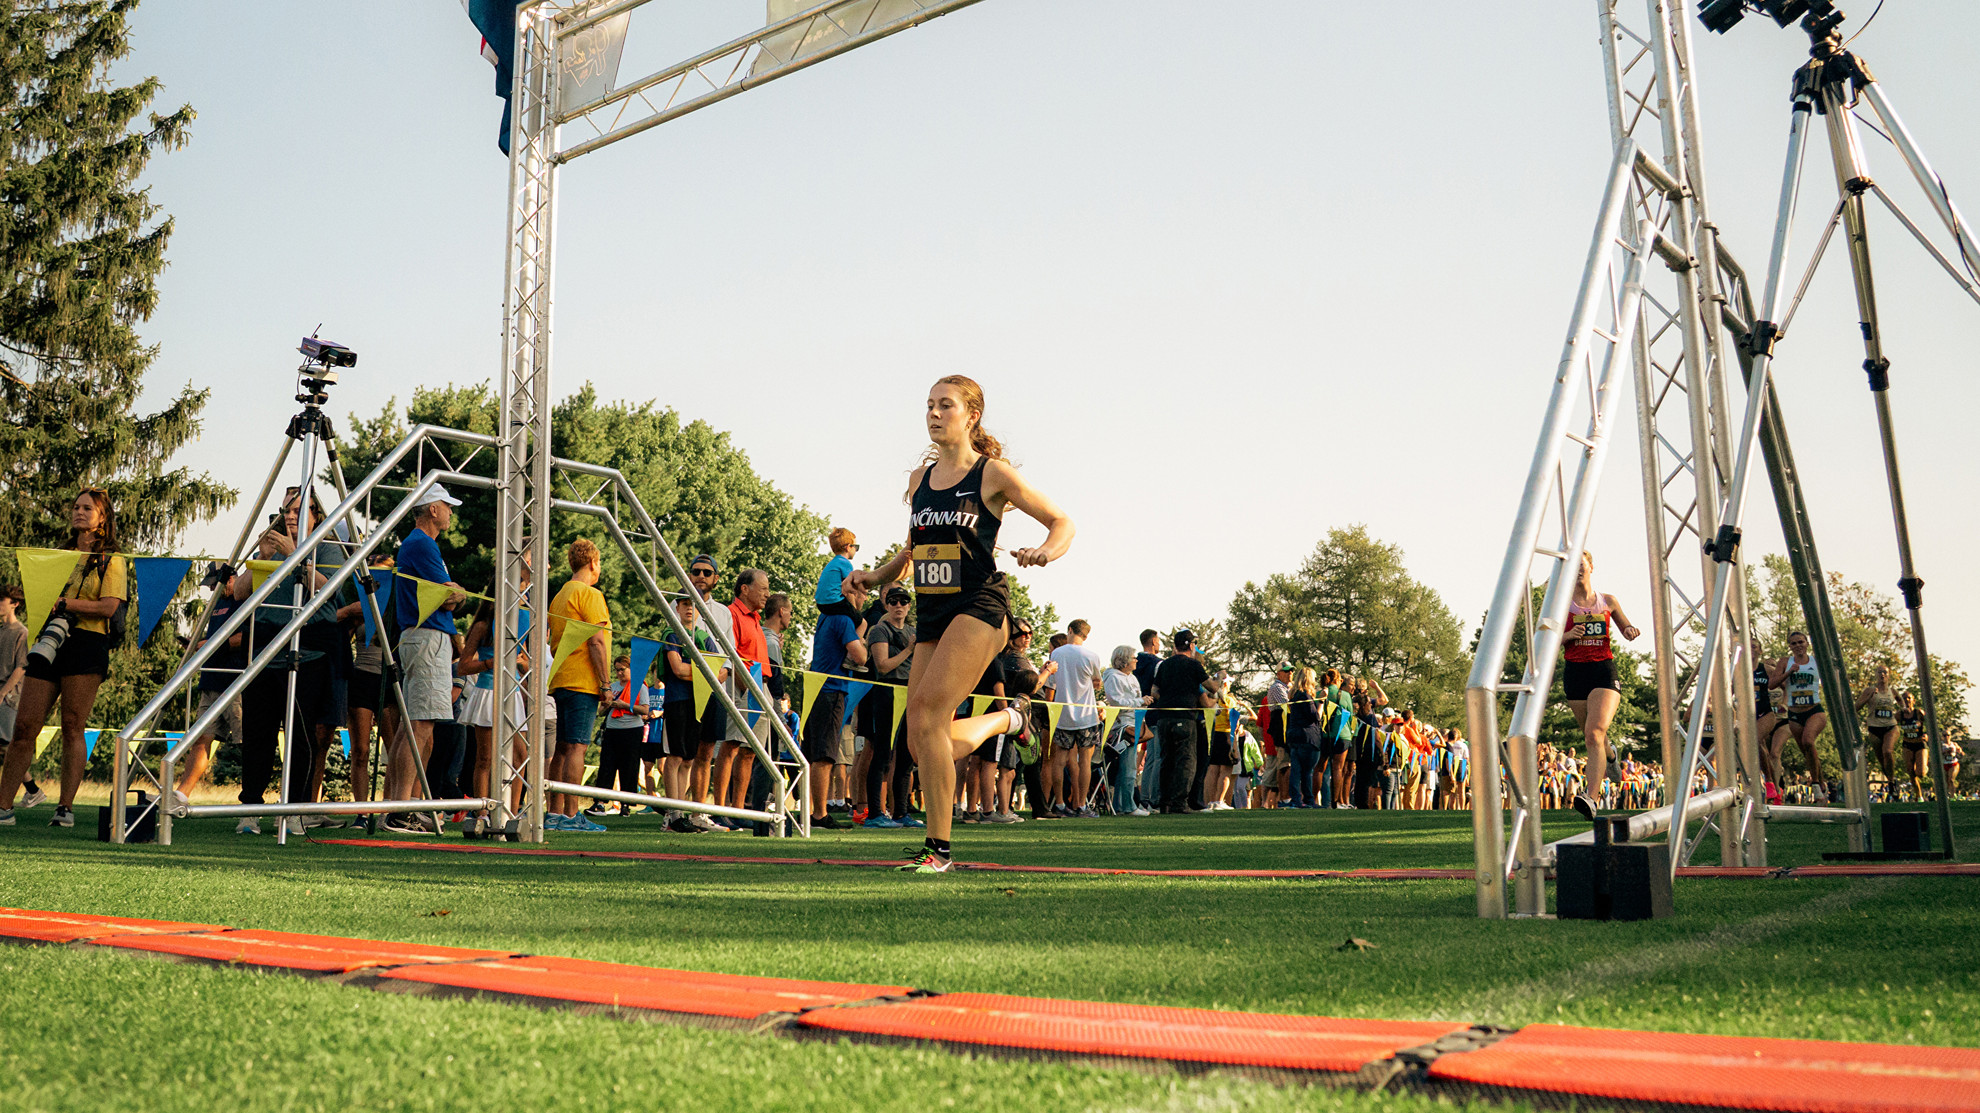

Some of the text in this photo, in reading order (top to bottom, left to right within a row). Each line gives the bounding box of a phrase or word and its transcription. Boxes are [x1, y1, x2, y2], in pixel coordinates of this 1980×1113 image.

[918, 562, 952, 585] 180
[1586, 622, 1602, 635] 36
[1795, 696, 1810, 704] 401
